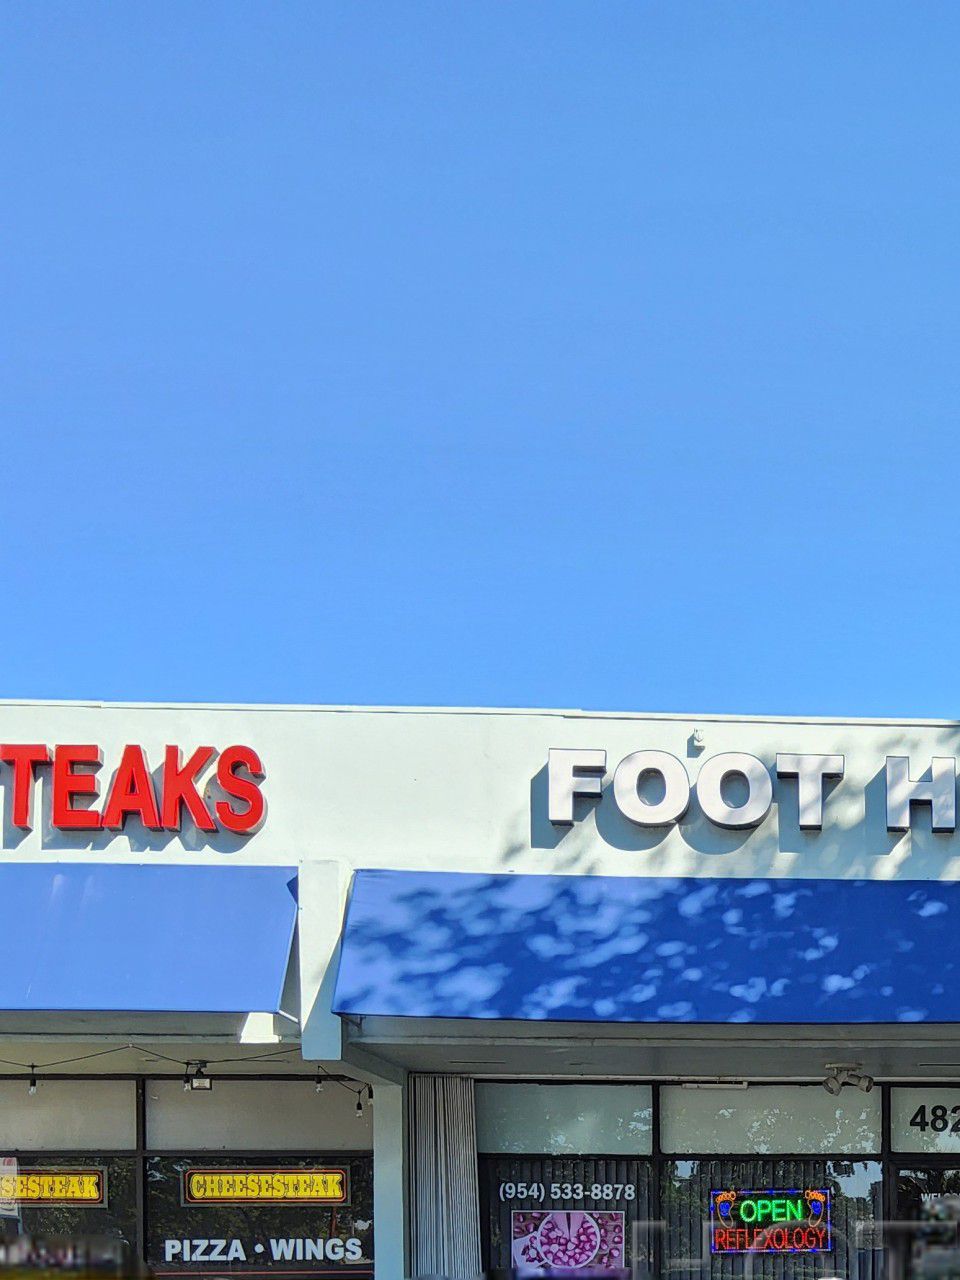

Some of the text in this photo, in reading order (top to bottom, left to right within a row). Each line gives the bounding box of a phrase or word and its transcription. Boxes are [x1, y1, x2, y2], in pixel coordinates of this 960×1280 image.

[547, 748, 845, 831] FOOT
[190, 1173, 344, 1199] CHEESESTEAK
[499, 1182, 636, 1202] (954) 533-8878
[739, 1199, 804, 1223] OPEN
[164, 1238, 363, 1262] PIZZA WINGS
[714, 1227, 827, 1250] REFLEXOLOGY
